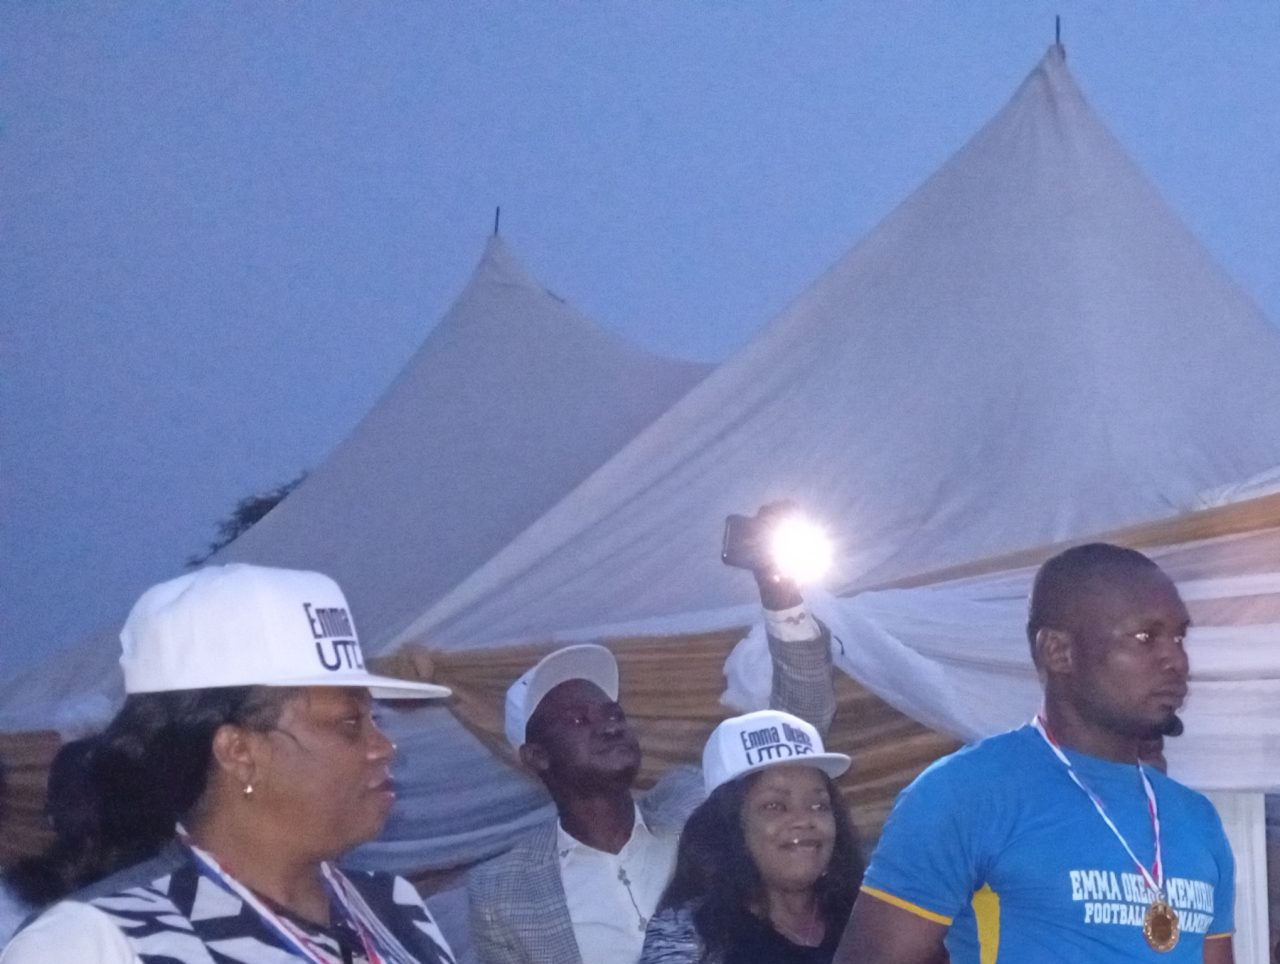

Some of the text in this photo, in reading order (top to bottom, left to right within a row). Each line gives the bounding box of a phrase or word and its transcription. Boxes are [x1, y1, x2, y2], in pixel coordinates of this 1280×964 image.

[740, 726, 780, 751] Emma
[1069, 870, 1122, 901] EMMA
[1121, 872, 1155, 904] OKE
